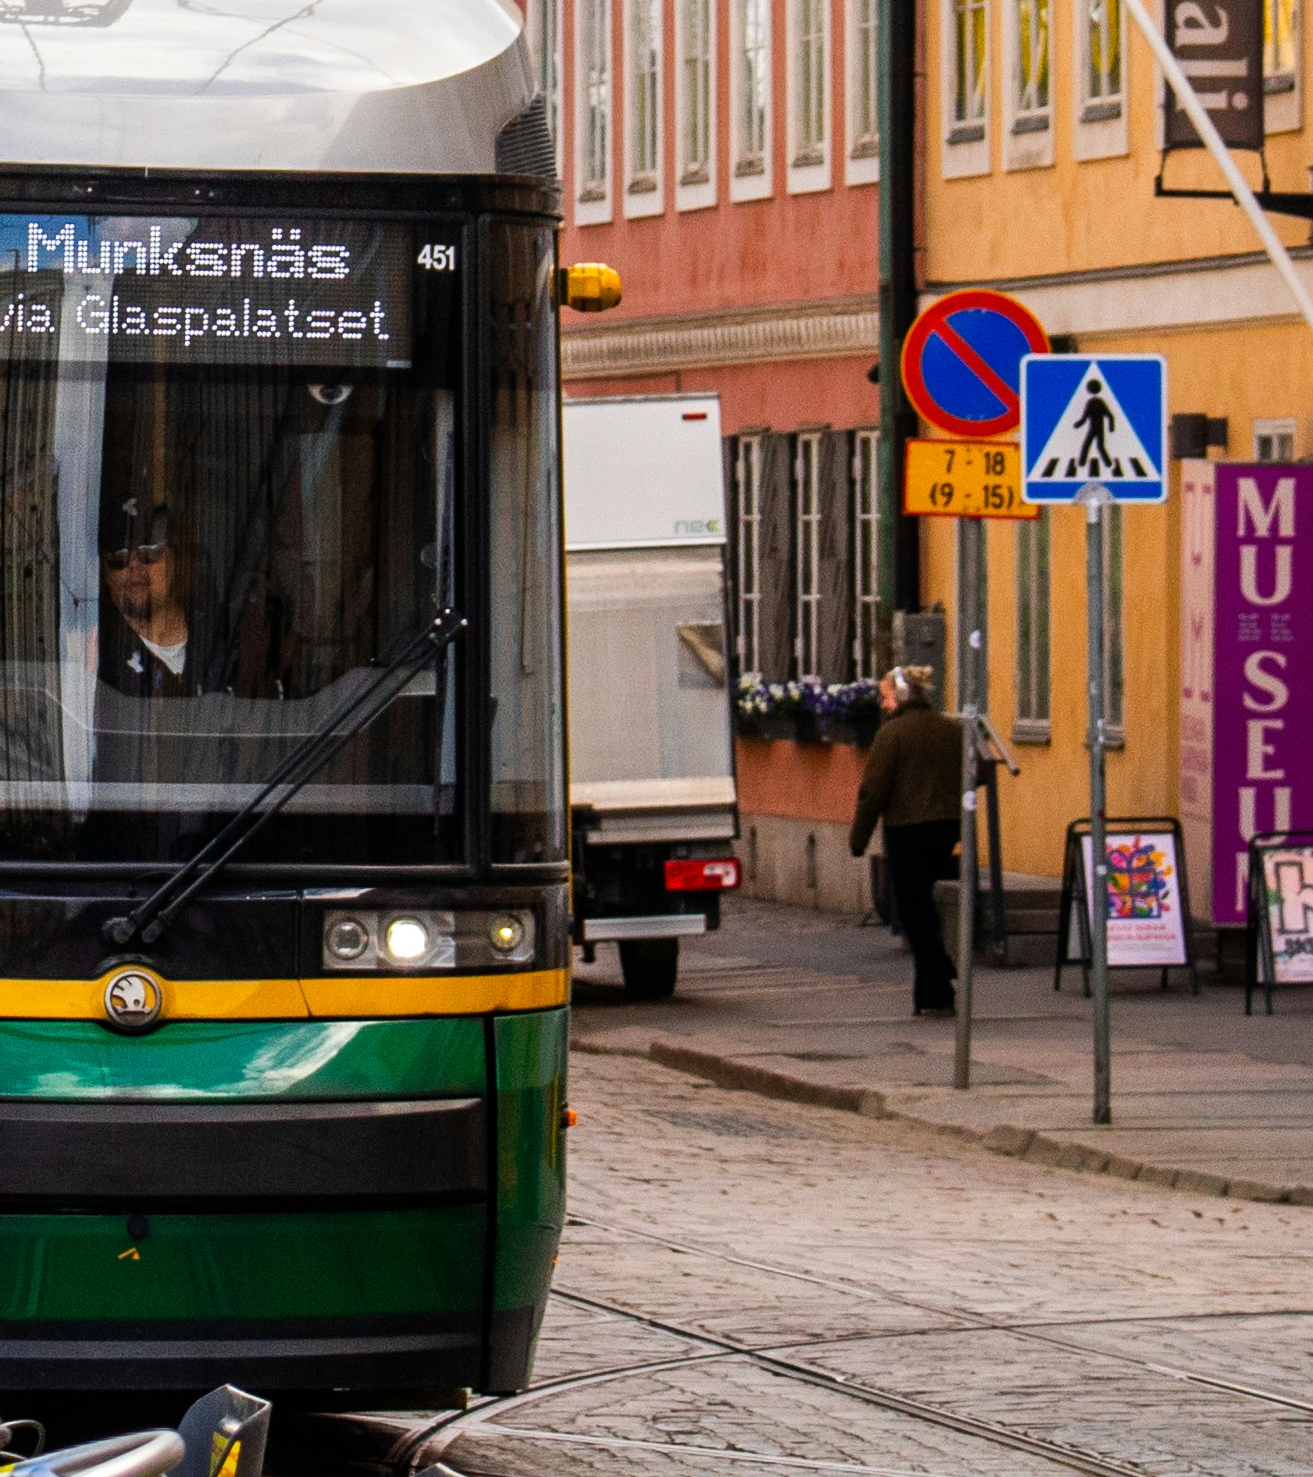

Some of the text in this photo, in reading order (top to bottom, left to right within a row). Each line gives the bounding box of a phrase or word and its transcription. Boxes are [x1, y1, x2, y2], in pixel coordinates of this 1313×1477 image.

[27, 223, 350, 279] Munksnäs
[417, 244, 456, 272] 451
[76, 295, 389, 346] Glaspalatset
[944, 448, 956, 474] 7
[984, 451, 1005, 476] 18
[929, 482, 955, 506] (9
[983, 484, 1014, 509] 15)
